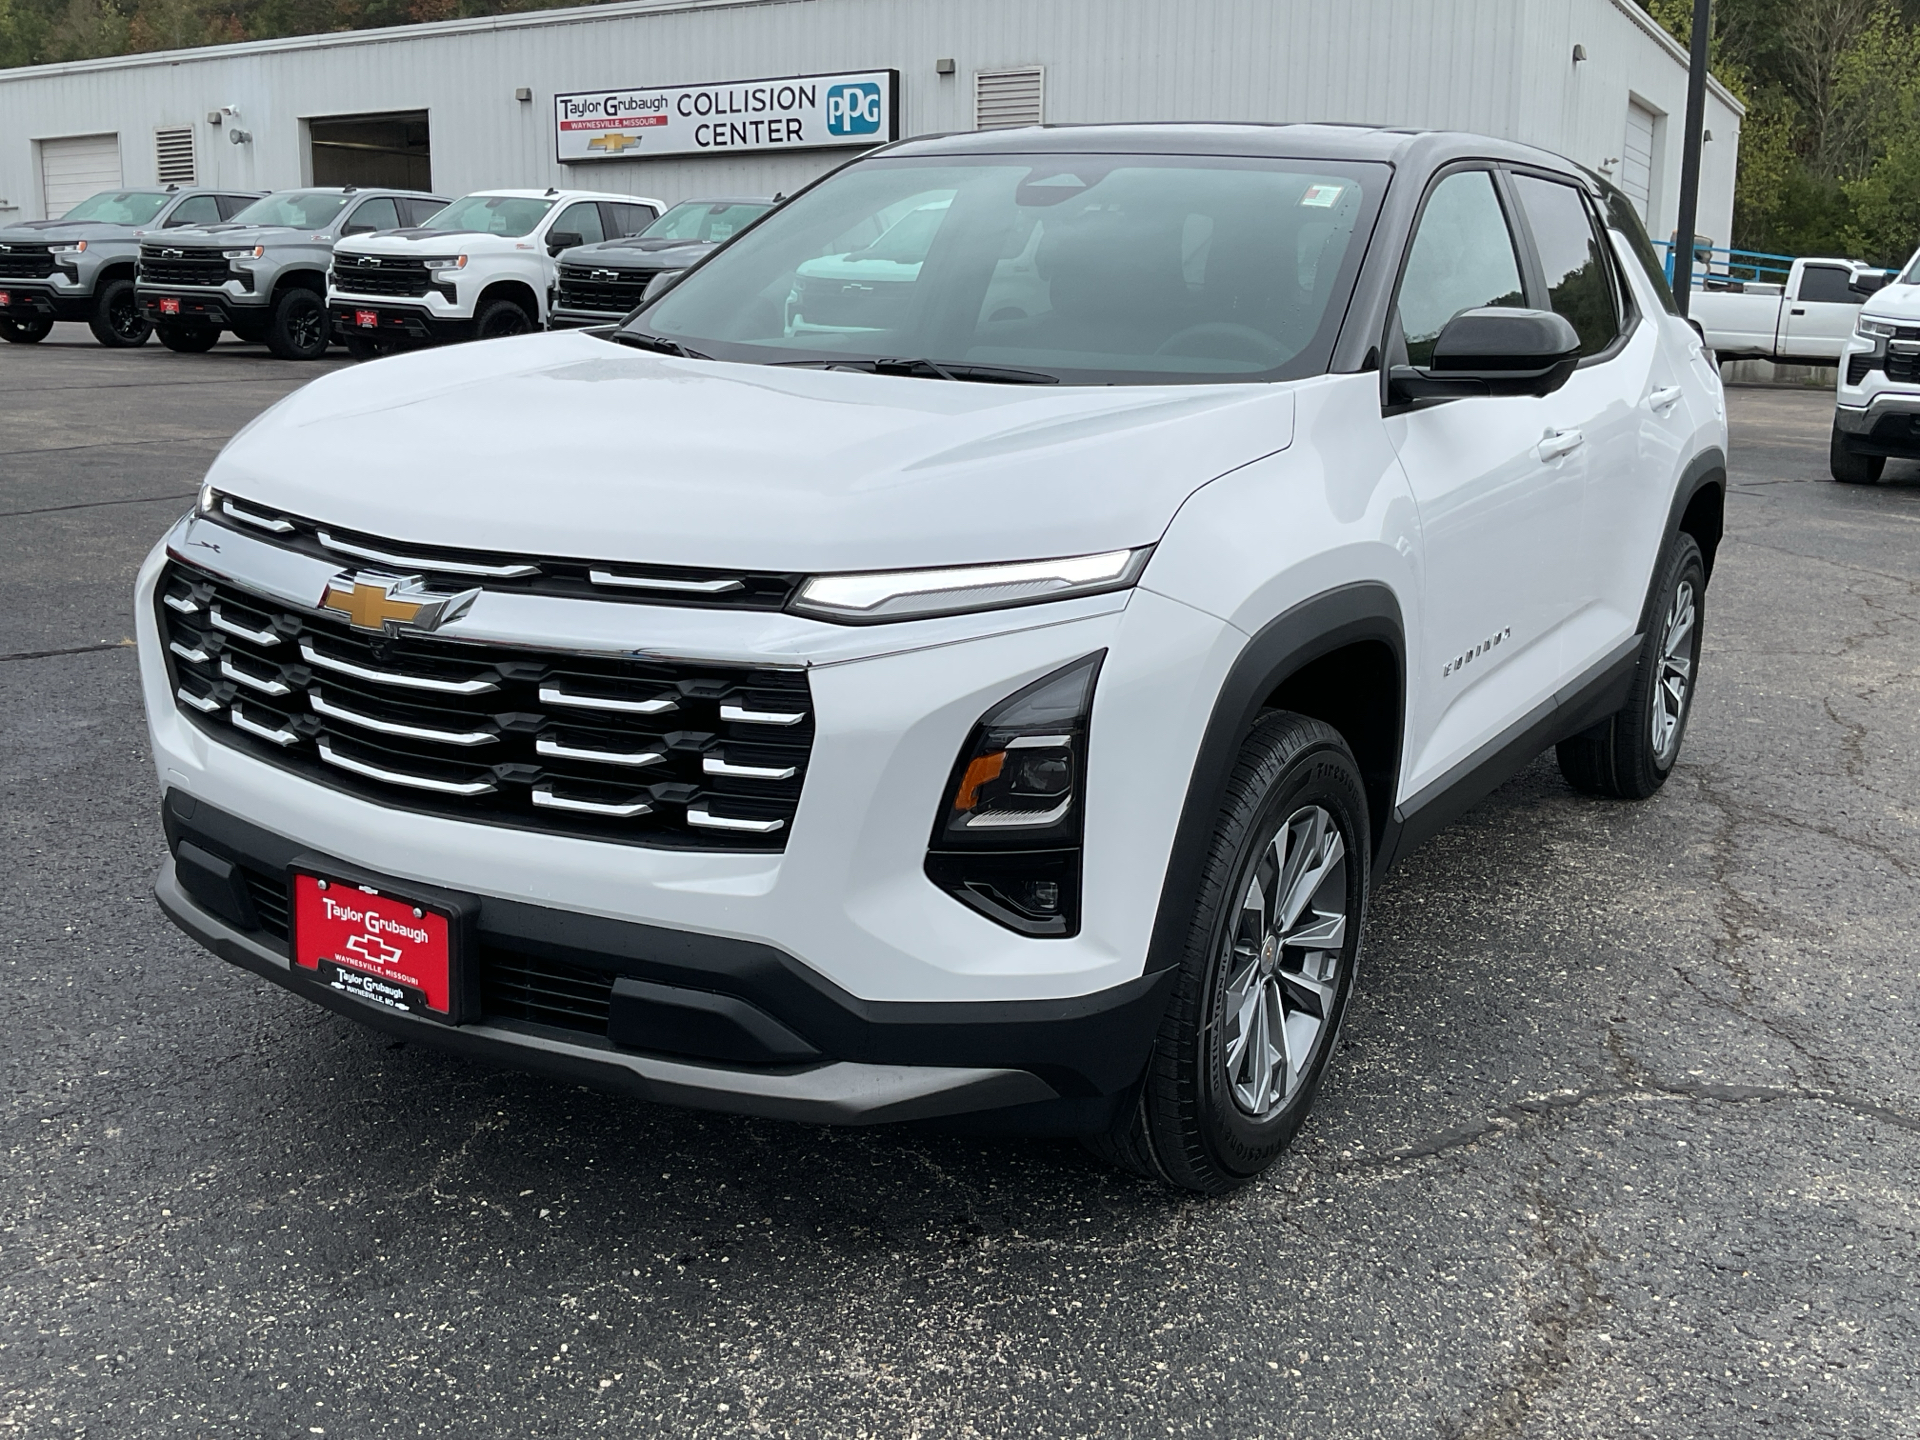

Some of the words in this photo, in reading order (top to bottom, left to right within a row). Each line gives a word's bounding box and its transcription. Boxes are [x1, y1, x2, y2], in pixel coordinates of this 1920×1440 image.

[559, 99, 601, 120] Taylor
[603, 94, 669, 116] Grubaugh
[676, 84, 816, 118] COLLISION
[571, 120, 622, 130] WAYNESVILLE,
[623, 117, 657, 127] MISSOURI
[694, 117, 804, 148] CENTER
[322, 897, 364, 921] Taylor
[364, 911, 429, 944] Grubaugh
[334, 953, 385, 976] WAYNESVILLE,
[385, 968, 419, 986] MISSOURI
[336, 967, 363, 985] Taylor
[363, 976, 404, 999] Grubaugh
[1211, 977, 1225, 1092] DESTINATION
